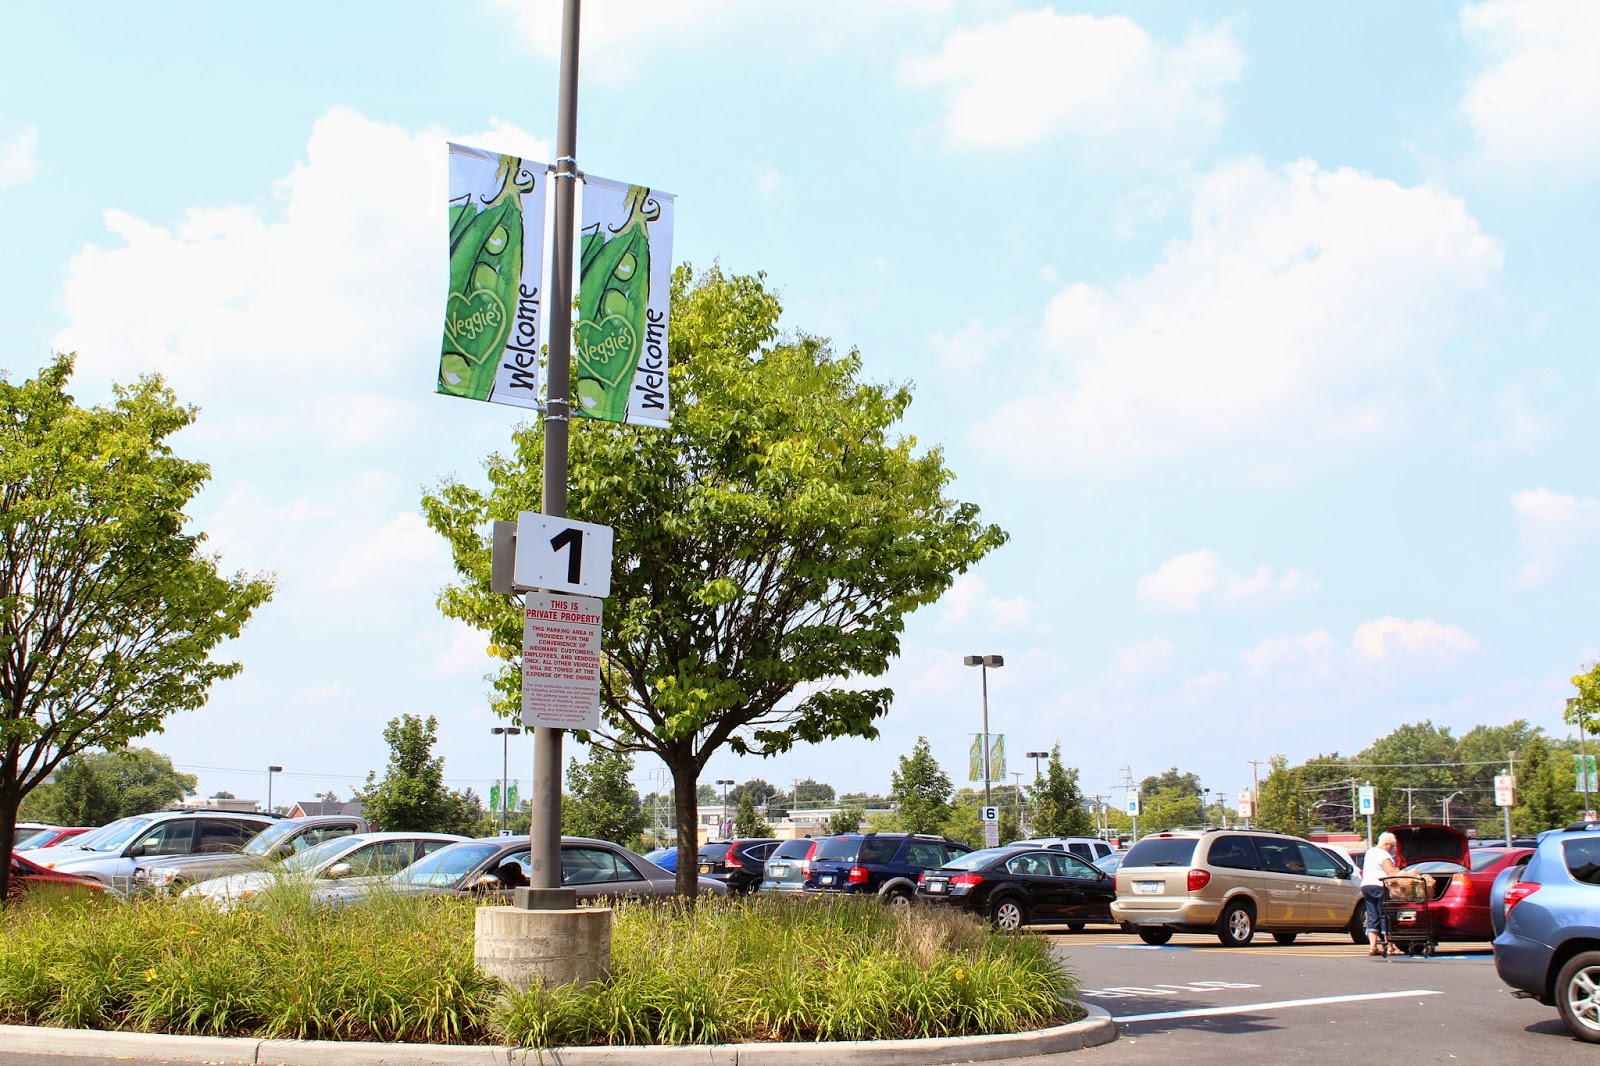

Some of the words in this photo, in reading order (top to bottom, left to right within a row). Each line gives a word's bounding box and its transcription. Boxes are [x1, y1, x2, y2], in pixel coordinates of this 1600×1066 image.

[503, 283, 539, 390] Welcome
[635, 309, 665, 410] Welcome
[550, 527, 584, 584] 1
[551, 600, 568, 609] THIS
[571, 601, 579, 610] IS
[526, 609, 558, 620] PRIVATE
[561, 612, 601, 623] PROPERTY
[561, 647, 596, 656] CUSTOMERS,
[986, 808, 995, 819] 6
